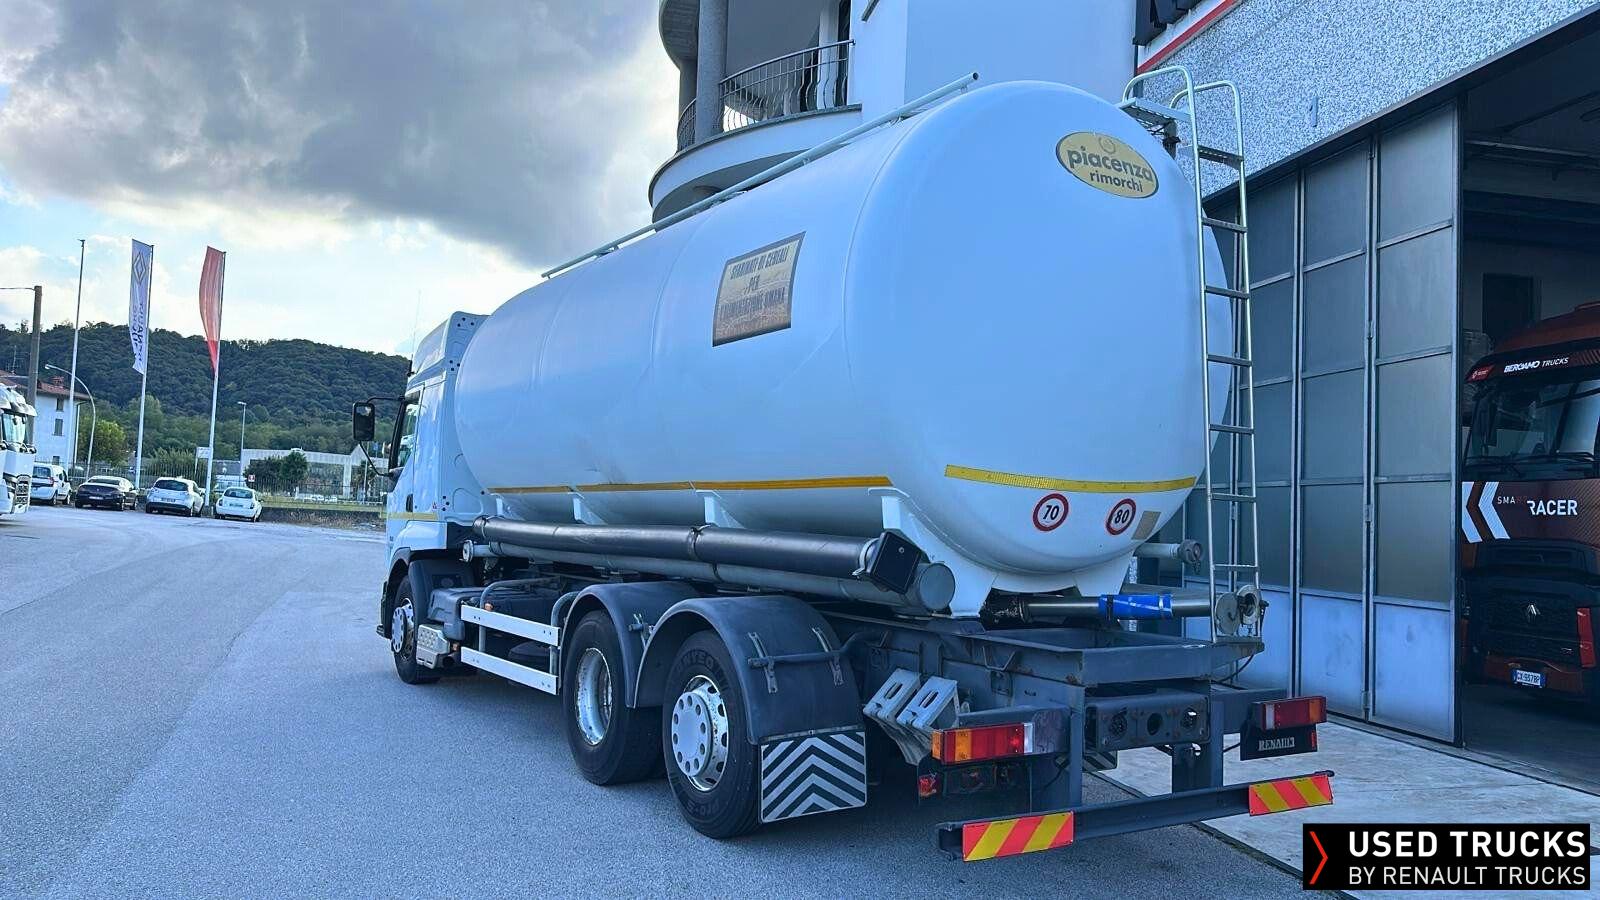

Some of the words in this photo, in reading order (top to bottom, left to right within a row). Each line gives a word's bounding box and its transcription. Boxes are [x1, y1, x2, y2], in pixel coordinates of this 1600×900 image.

[1066, 145, 1154, 182] piacenza
[1089, 170, 1143, 193] rimorchi
[747, 274, 761, 294] PER
[1503, 360, 1541, 374] BERGAMO
[1541, 357, 1569, 368] TRUCKS
[1043, 504, 1060, 521] 70
[1526, 499, 1578, 516] RACER
[1114, 509, 1130, 524] 80
